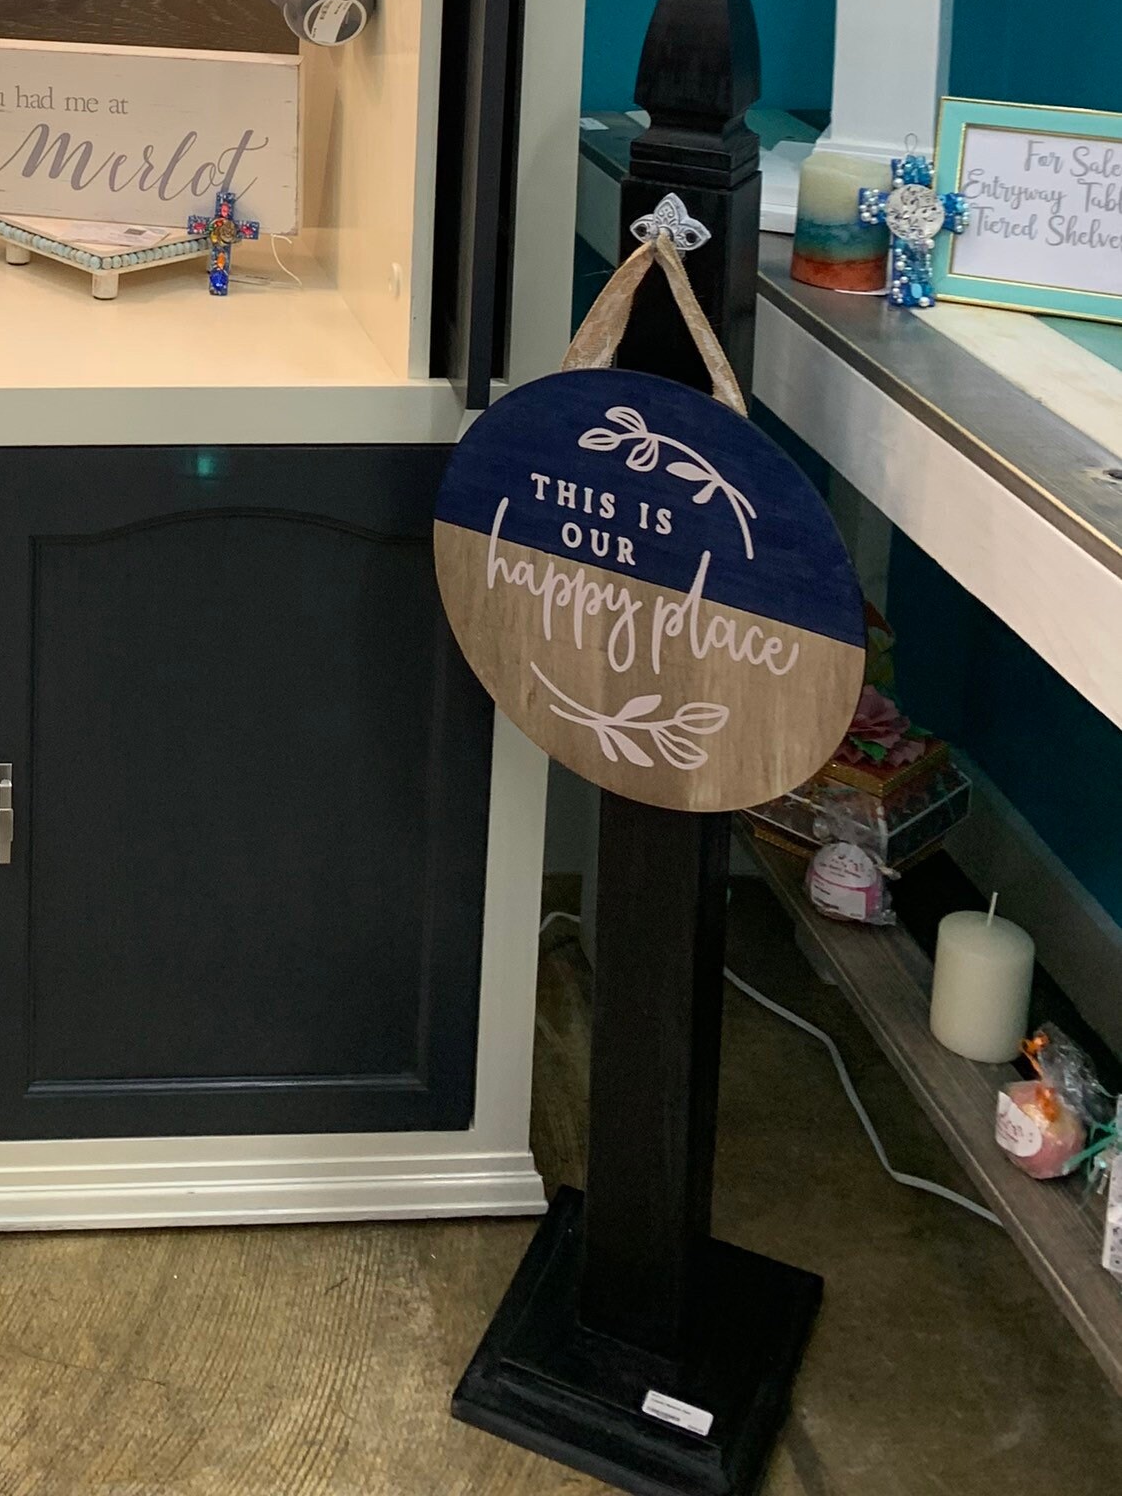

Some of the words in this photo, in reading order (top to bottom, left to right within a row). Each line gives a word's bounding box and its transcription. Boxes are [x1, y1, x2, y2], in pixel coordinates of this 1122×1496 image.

[15, 85, 55, 110] had
[64, 95, 99, 113] me
[108, 97, 129, 115] at
[1024, 140, 1063, 174] For
[1070, 145, 1122, 178] Sale
[963, 168, 1068, 215] Entryway
[968, 202, 1038, 241] Tiered
[1045, 214, 1122, 253] Shelve
[530, 472, 616, 520] THIS
[639, 502, 673, 535] IS
[561, 522, 636, 566] OUR
[487, 497, 642, 672] happy
[651, 550, 799, 675] place
